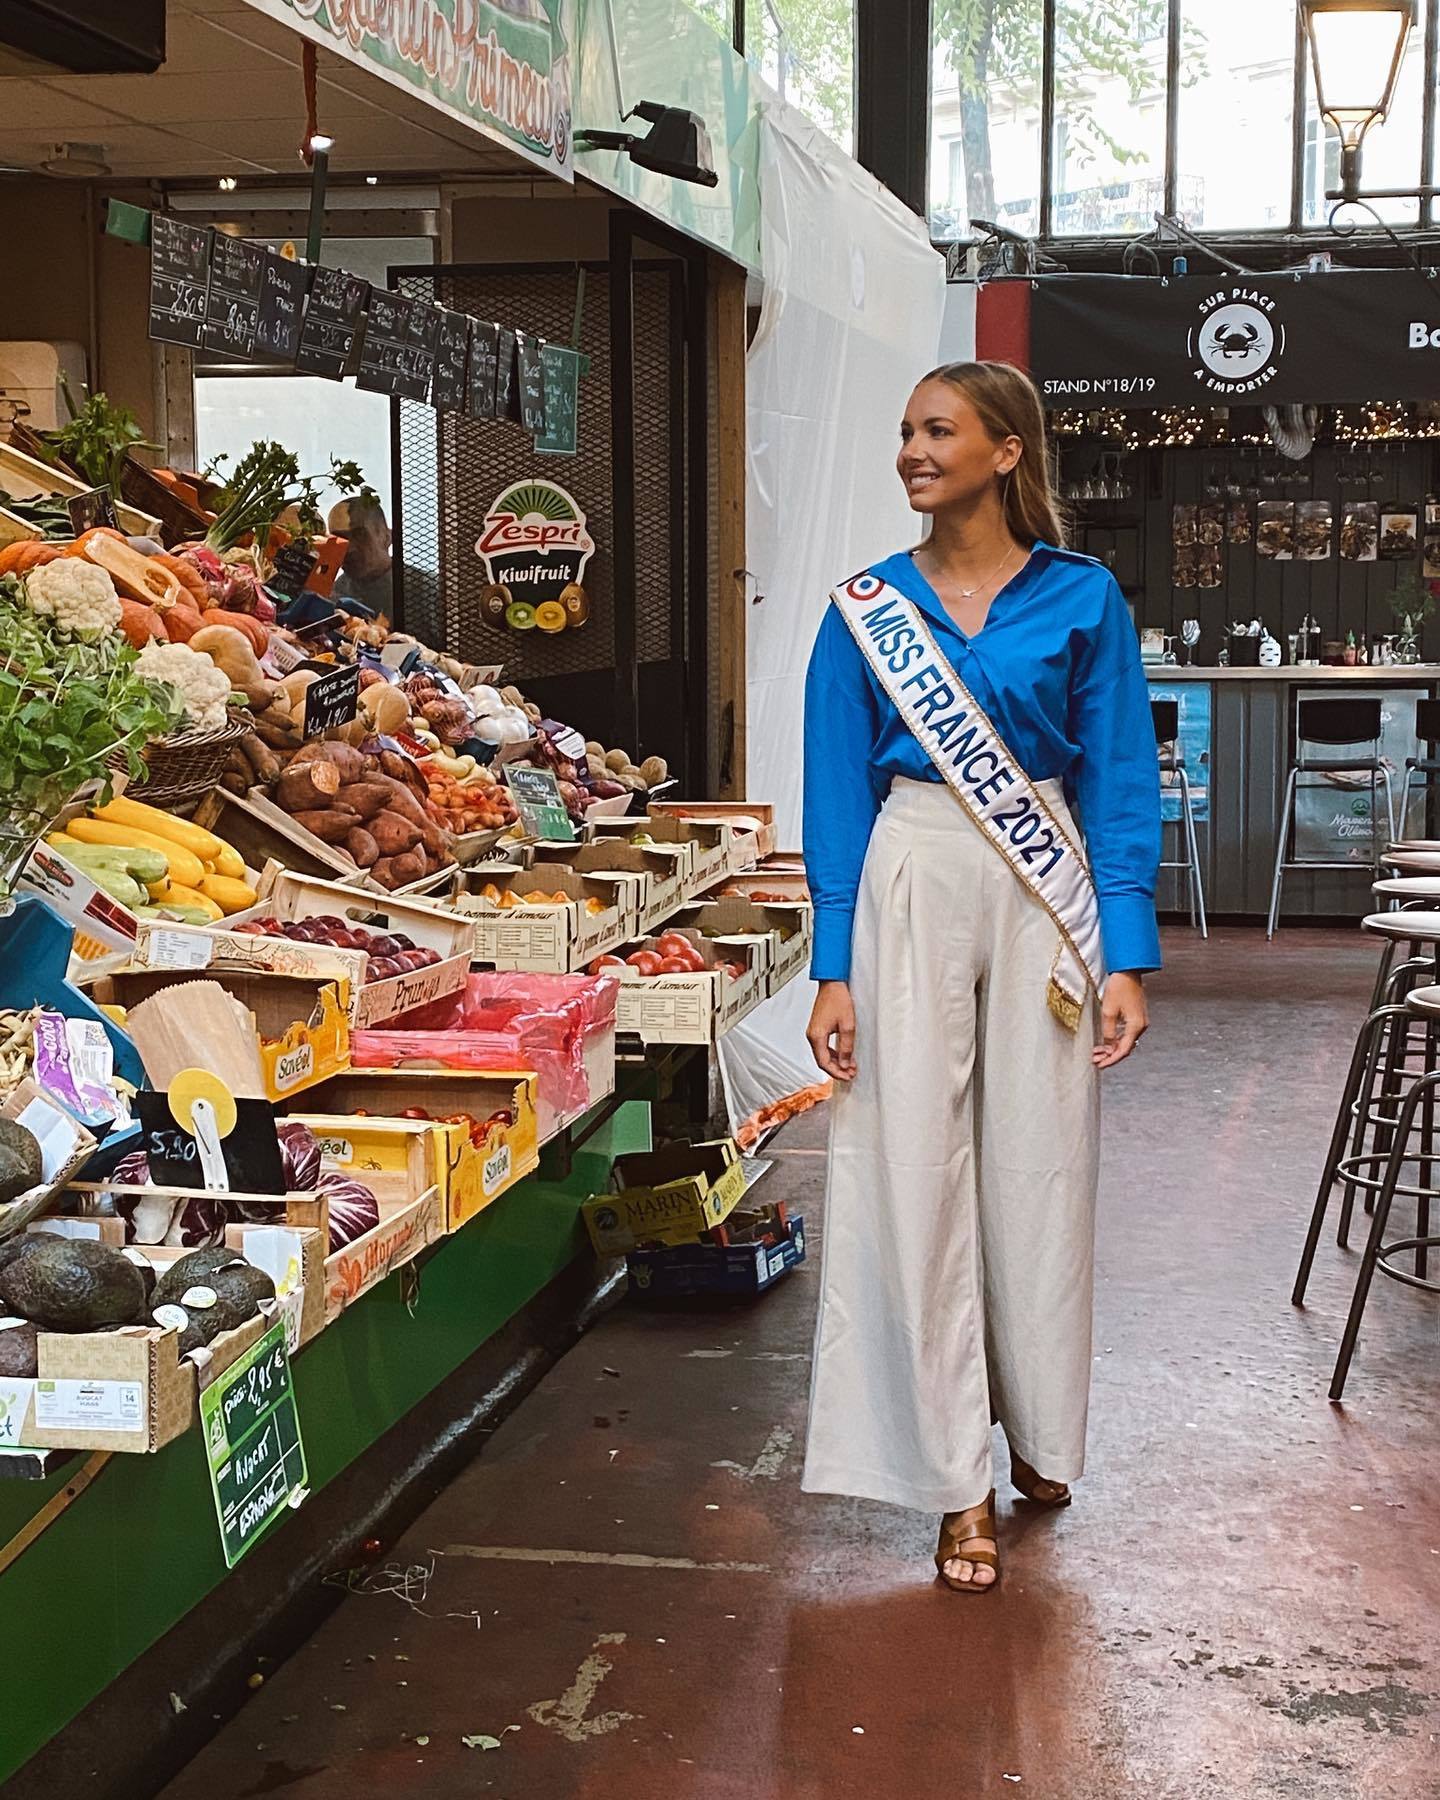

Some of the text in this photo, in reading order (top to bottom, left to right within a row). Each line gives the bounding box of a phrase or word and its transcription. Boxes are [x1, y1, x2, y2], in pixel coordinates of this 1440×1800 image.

[1199, 288, 1276, 313] SUR PLACE
[1043, 380, 1091, 394] STAND
[1193, 366, 1278, 393] A EMPORTER
[480, 515, 581, 553] Zespri
[498, 565, 571, 585] Kiwifruit
[861, 600, 1065, 878] MISS FRANCE 2021
[319, 1139, 348, 1155] éol
